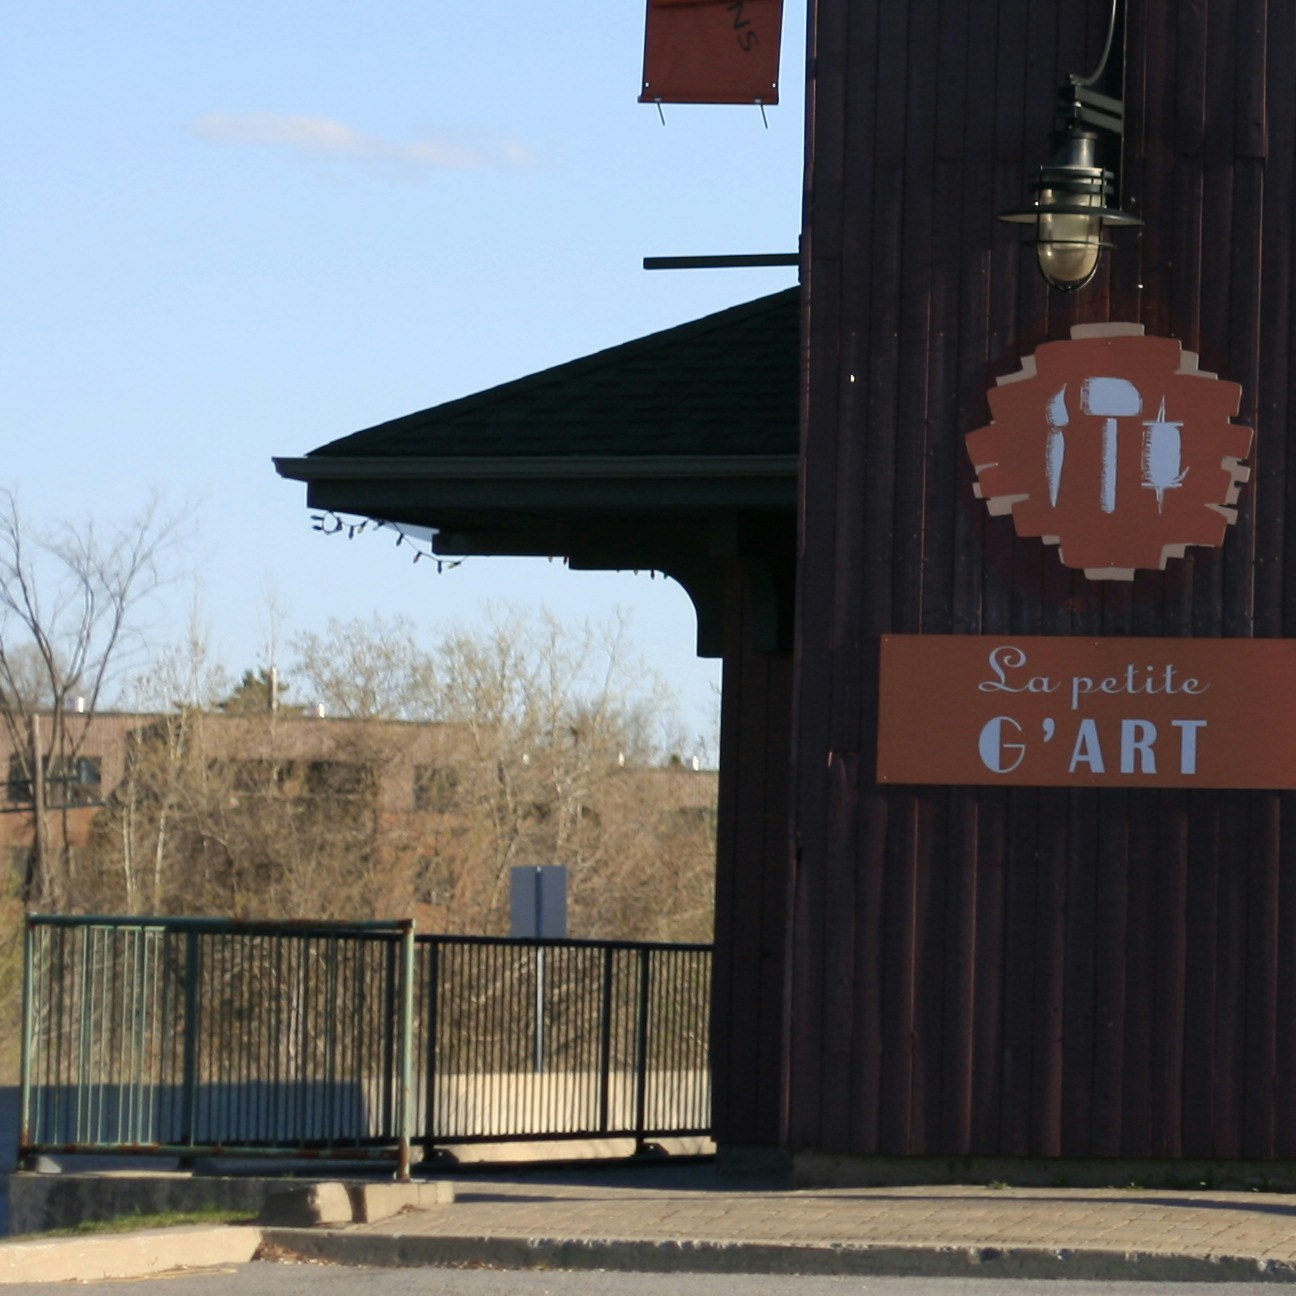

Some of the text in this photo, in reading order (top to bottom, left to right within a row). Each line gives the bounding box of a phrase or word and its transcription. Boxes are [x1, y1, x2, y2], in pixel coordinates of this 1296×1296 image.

[978, 645, 1212, 711] La petite
[978, 715, 1208, 775] G'ART
